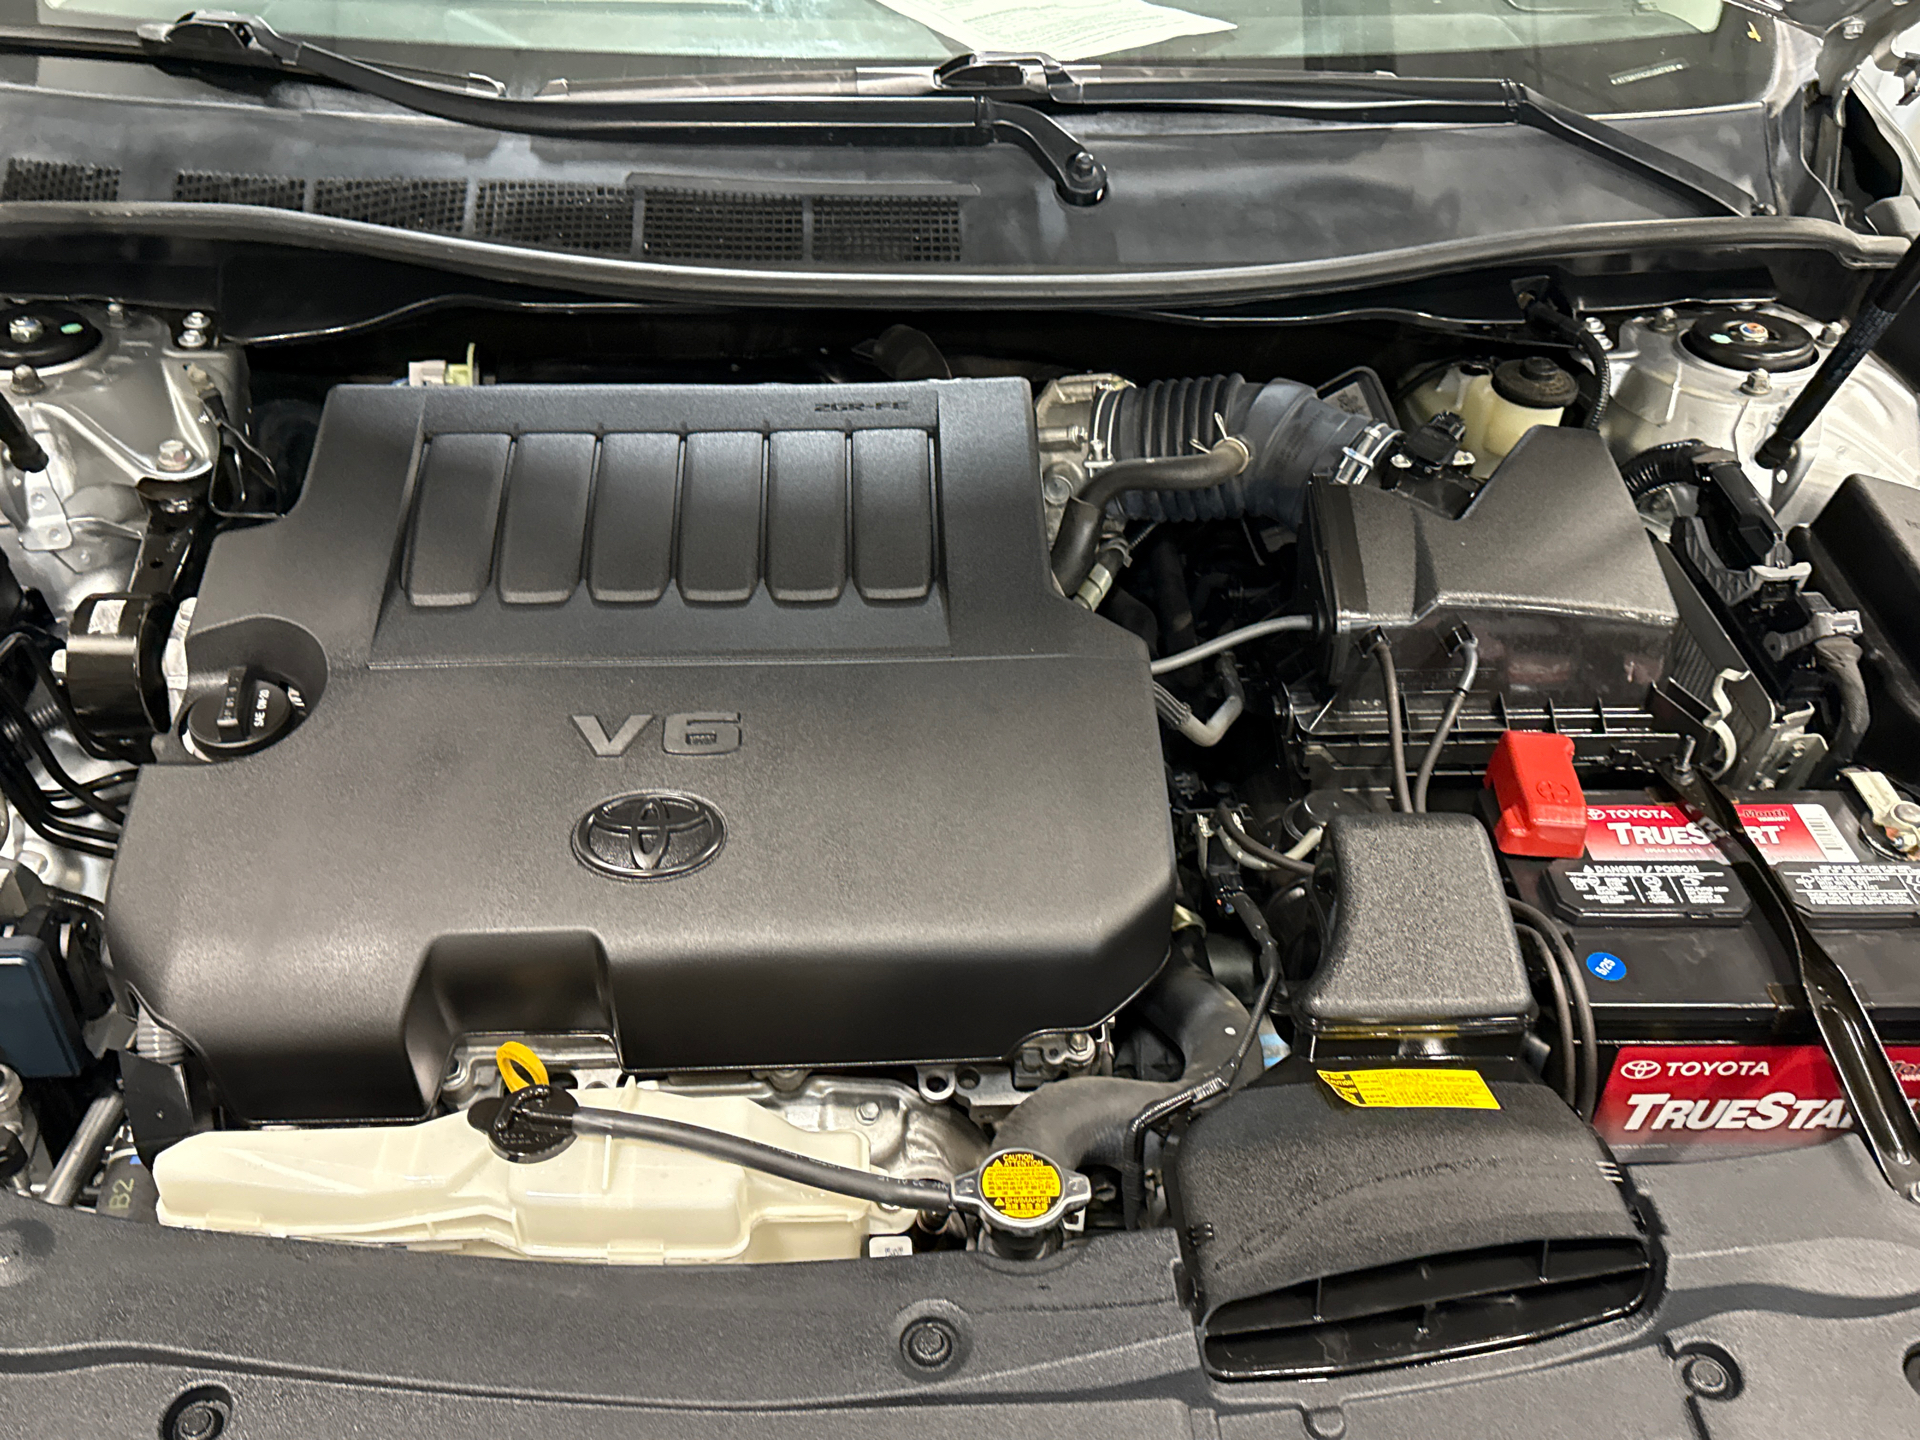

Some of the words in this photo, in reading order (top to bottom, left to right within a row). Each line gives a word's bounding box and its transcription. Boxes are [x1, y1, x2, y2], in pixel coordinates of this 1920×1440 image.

[569, 712, 743, 758] V6
[1605, 809, 1674, 820] TOYOTA
[1593, 865, 1645, 873] DANGER
[1653, 865, 1700, 873] POISON
[1665, 1060, 1770, 1077] TOYOTA
[109, 1178, 135, 1209] B2
